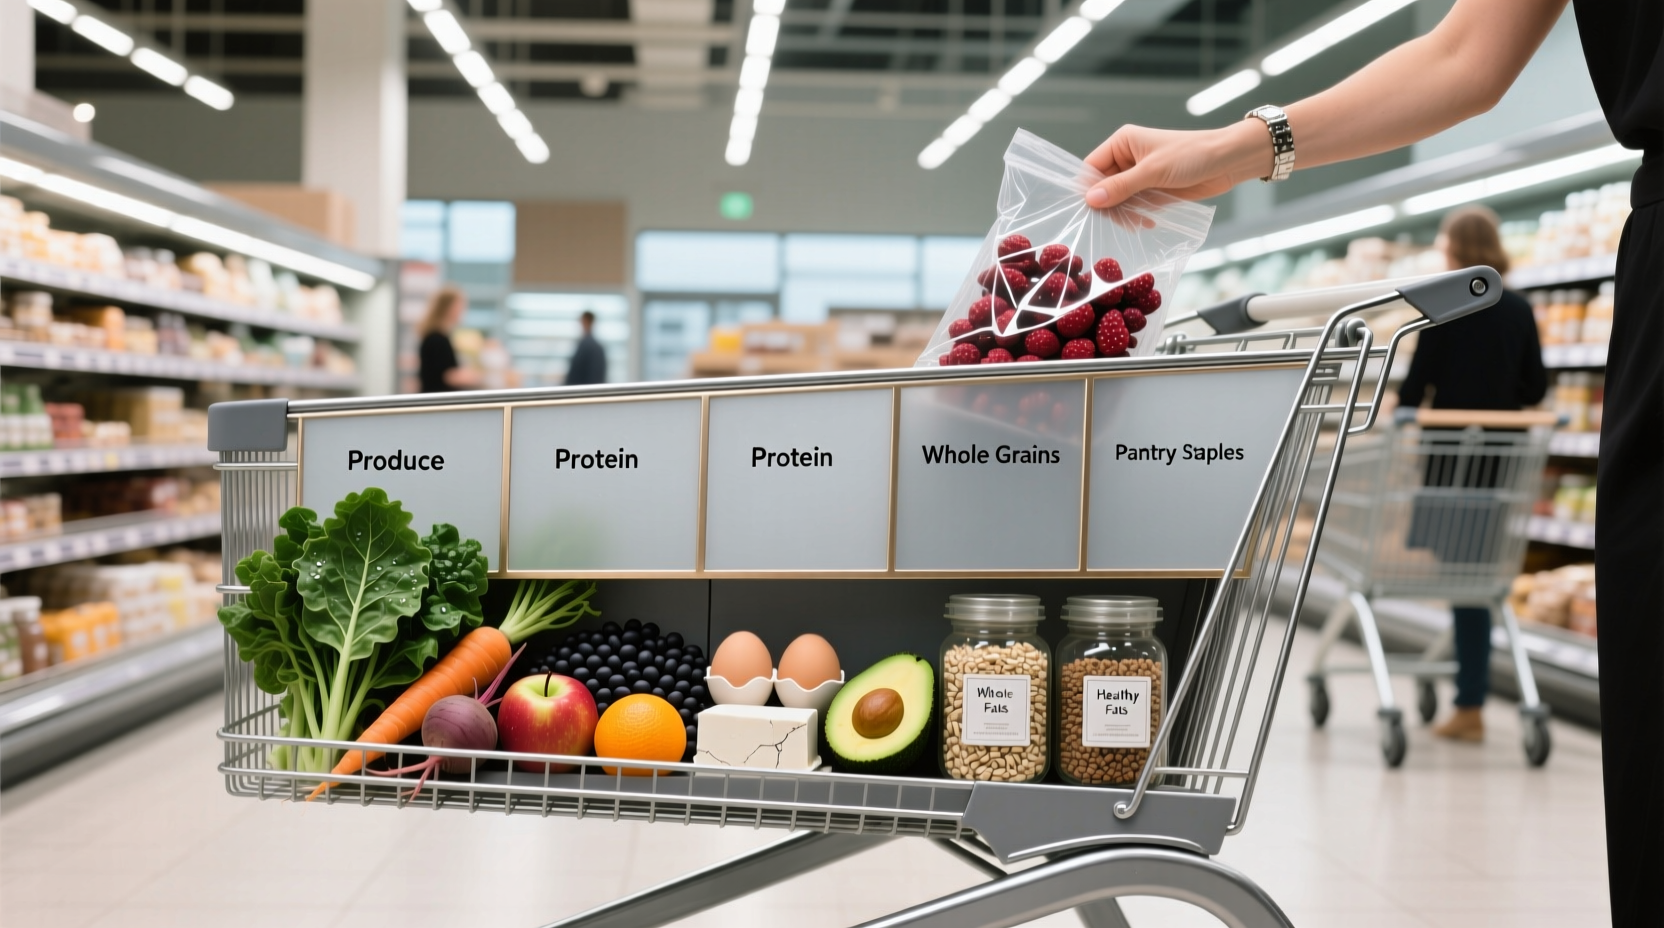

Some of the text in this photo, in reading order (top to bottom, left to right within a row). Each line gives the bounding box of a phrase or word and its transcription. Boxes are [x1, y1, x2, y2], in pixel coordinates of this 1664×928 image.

[348, 449, 445, 471] Produce
[555, 448, 639, 470] Protein
[751, 446, 833, 468] Protein
[921, 444, 1061, 465] Whole Grains
[1115, 444, 1177, 466] Pantry
